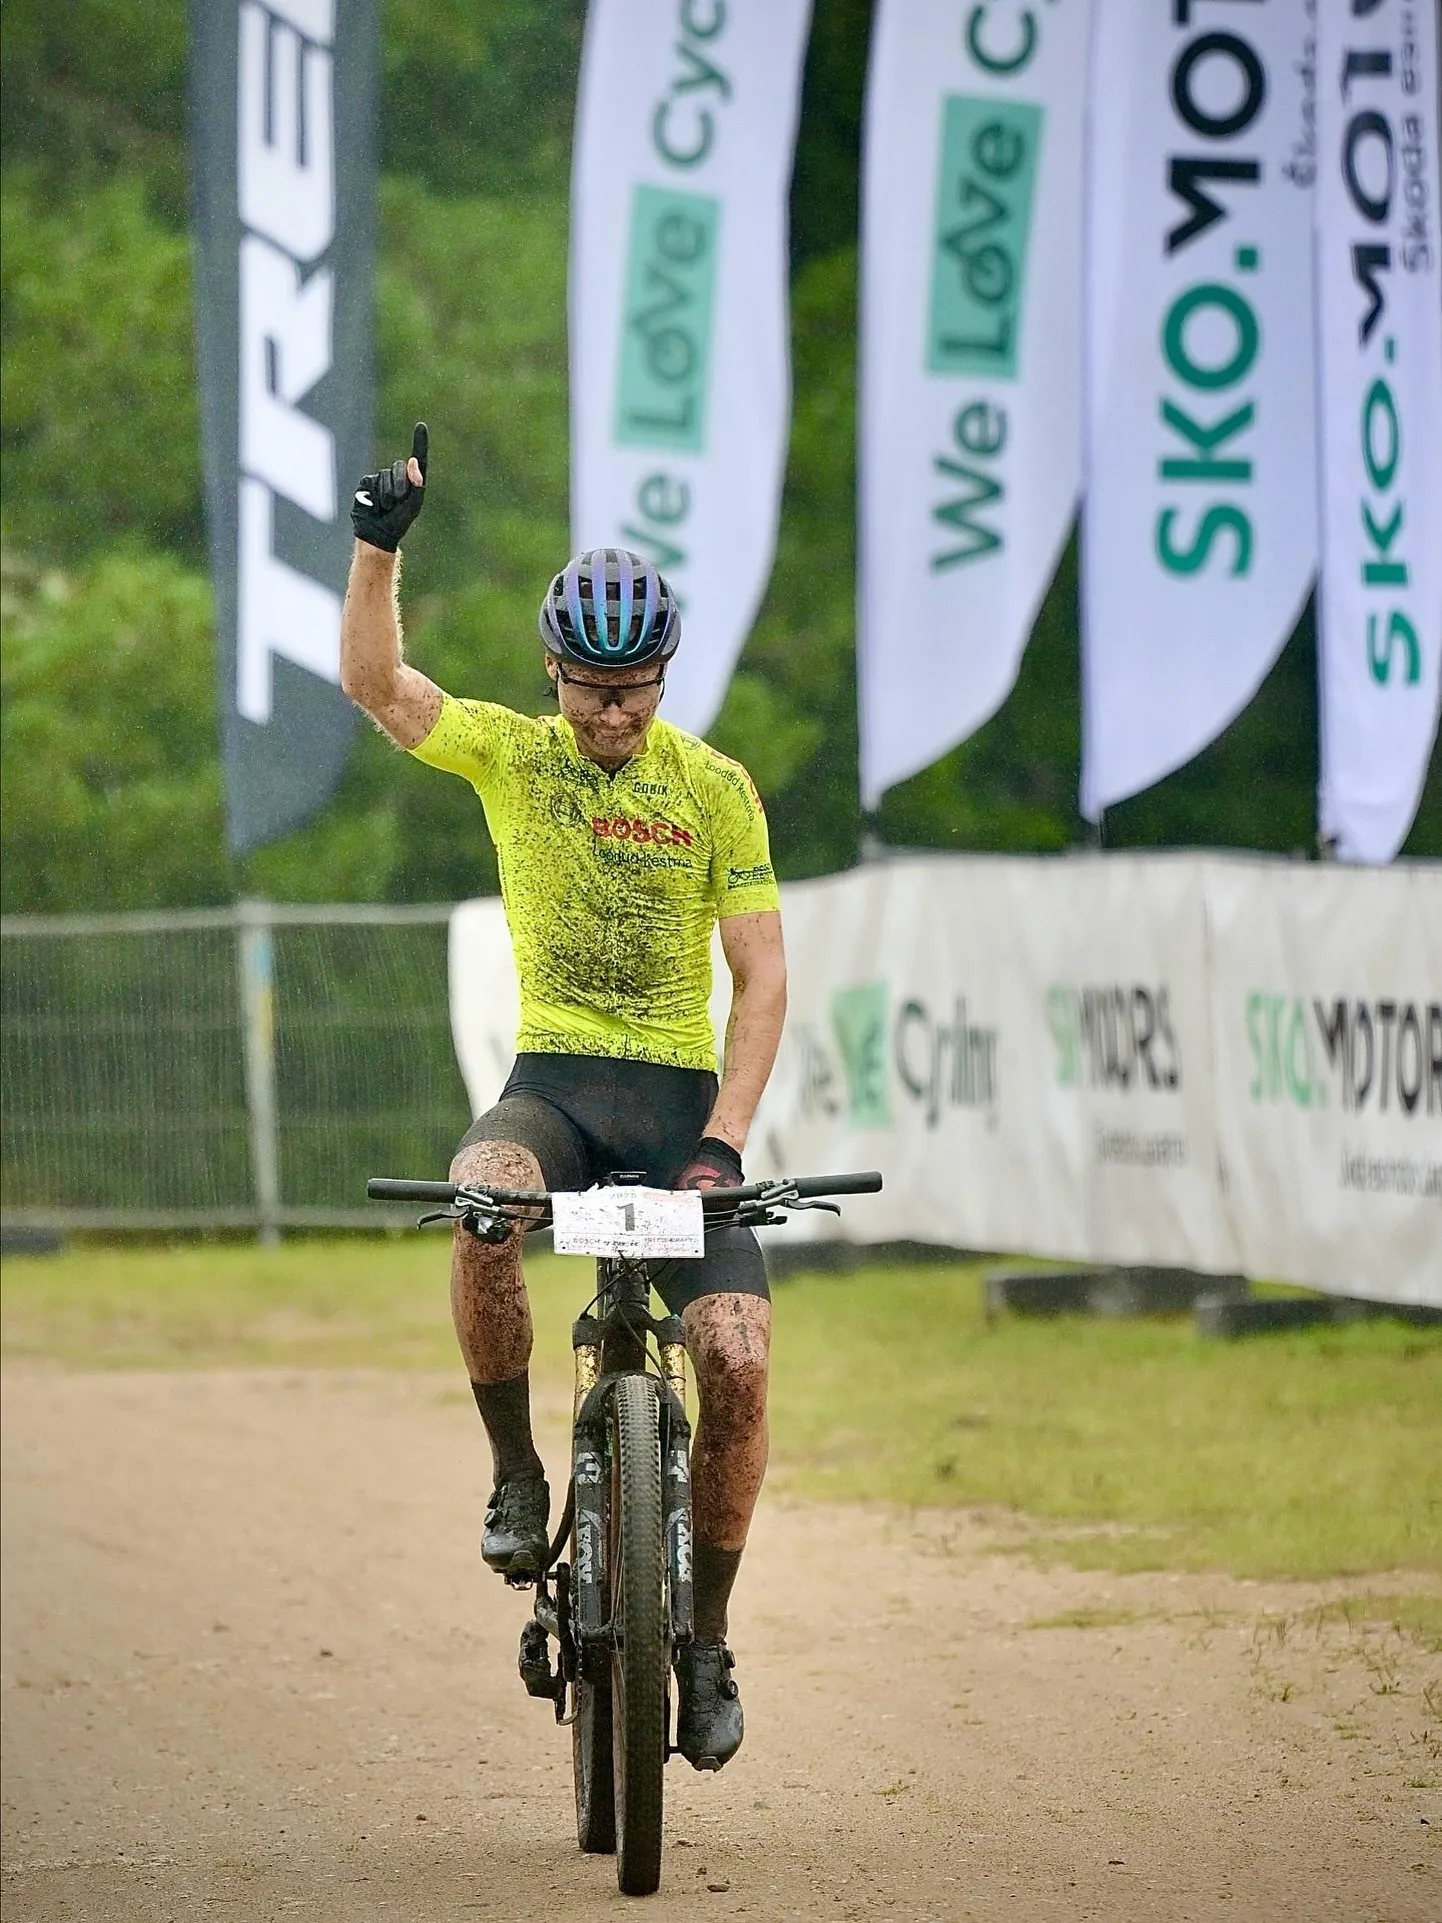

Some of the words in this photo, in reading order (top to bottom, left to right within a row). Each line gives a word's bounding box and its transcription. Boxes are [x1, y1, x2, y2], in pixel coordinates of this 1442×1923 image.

[627, 205, 707, 433] Love
[939, 121, 1025, 360] Love
[1341, 0, 1421, 687] SKO.MOT
[237, 0, 344, 725] TRE
[929, 400, 1010, 573] We
[592, 817, 692, 846] BOSCH
[616, 1203, 635, 1231] 1
